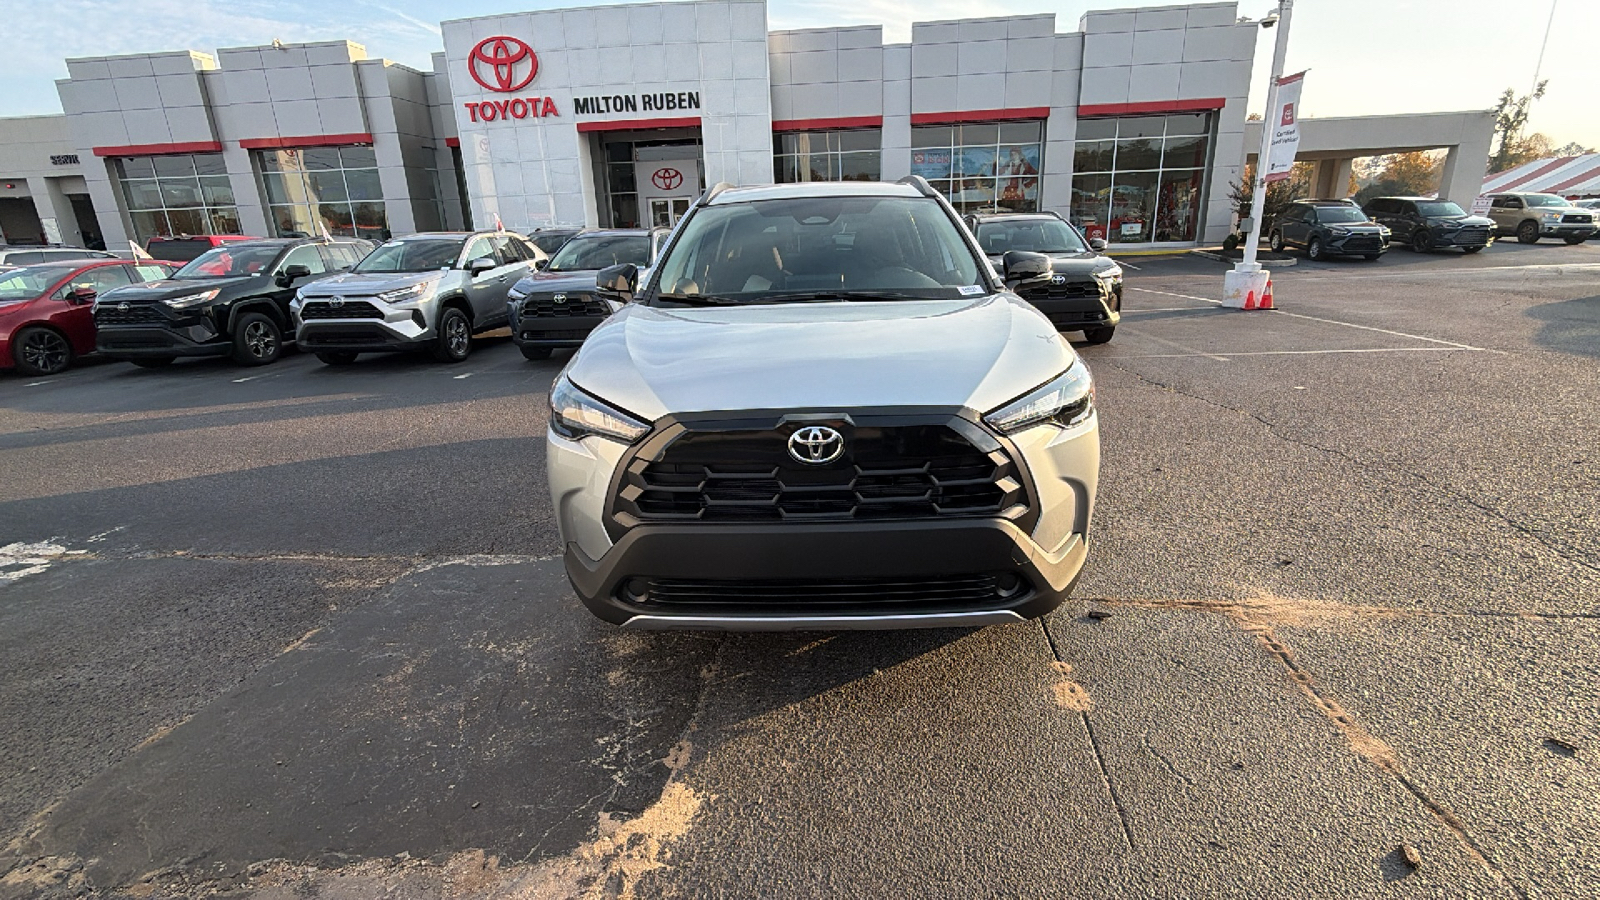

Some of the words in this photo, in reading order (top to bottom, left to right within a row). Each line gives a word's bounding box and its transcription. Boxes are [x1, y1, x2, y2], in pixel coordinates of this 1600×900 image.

[464, 96, 559, 123] TOYOTA
[574, 94, 637, 115] MILTON
[641, 91, 701, 111] RUBEN
